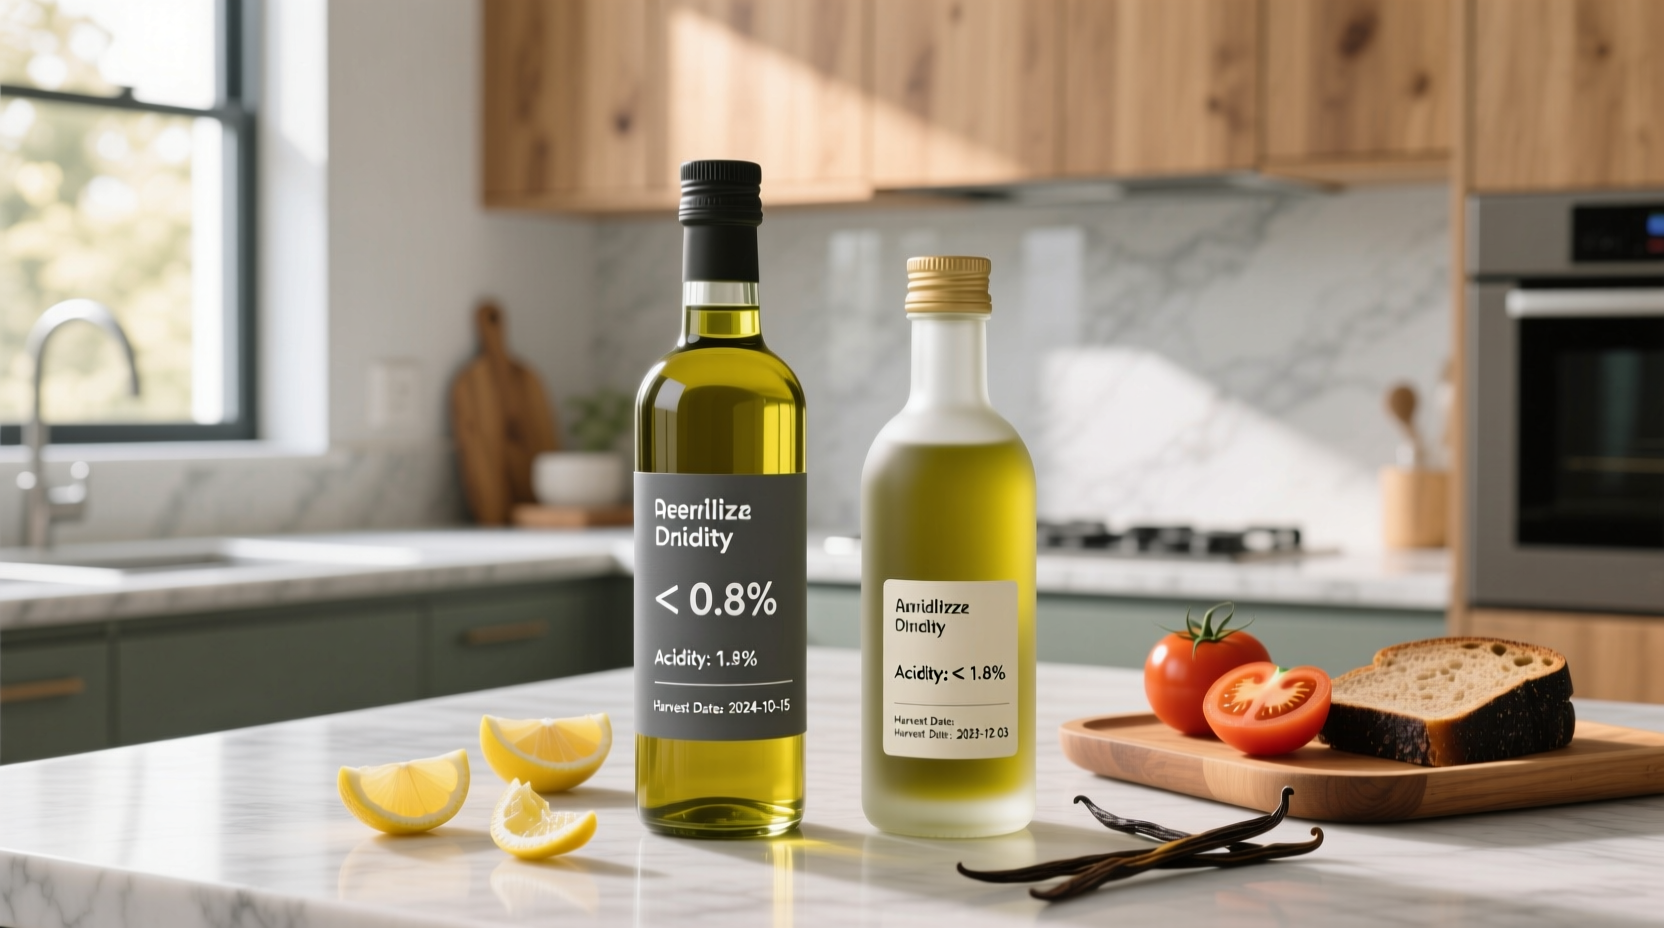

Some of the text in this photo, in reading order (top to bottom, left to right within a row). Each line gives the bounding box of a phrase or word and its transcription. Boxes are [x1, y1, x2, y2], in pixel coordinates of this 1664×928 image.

[655, 581, 777, 616] < 0.8%
[654, 648, 711, 670] Acidity:
[952, 666, 965, 680] <
[971, 664, 1006, 681] 1.8%
[728, 698, 791, 714] 2024-10-15
